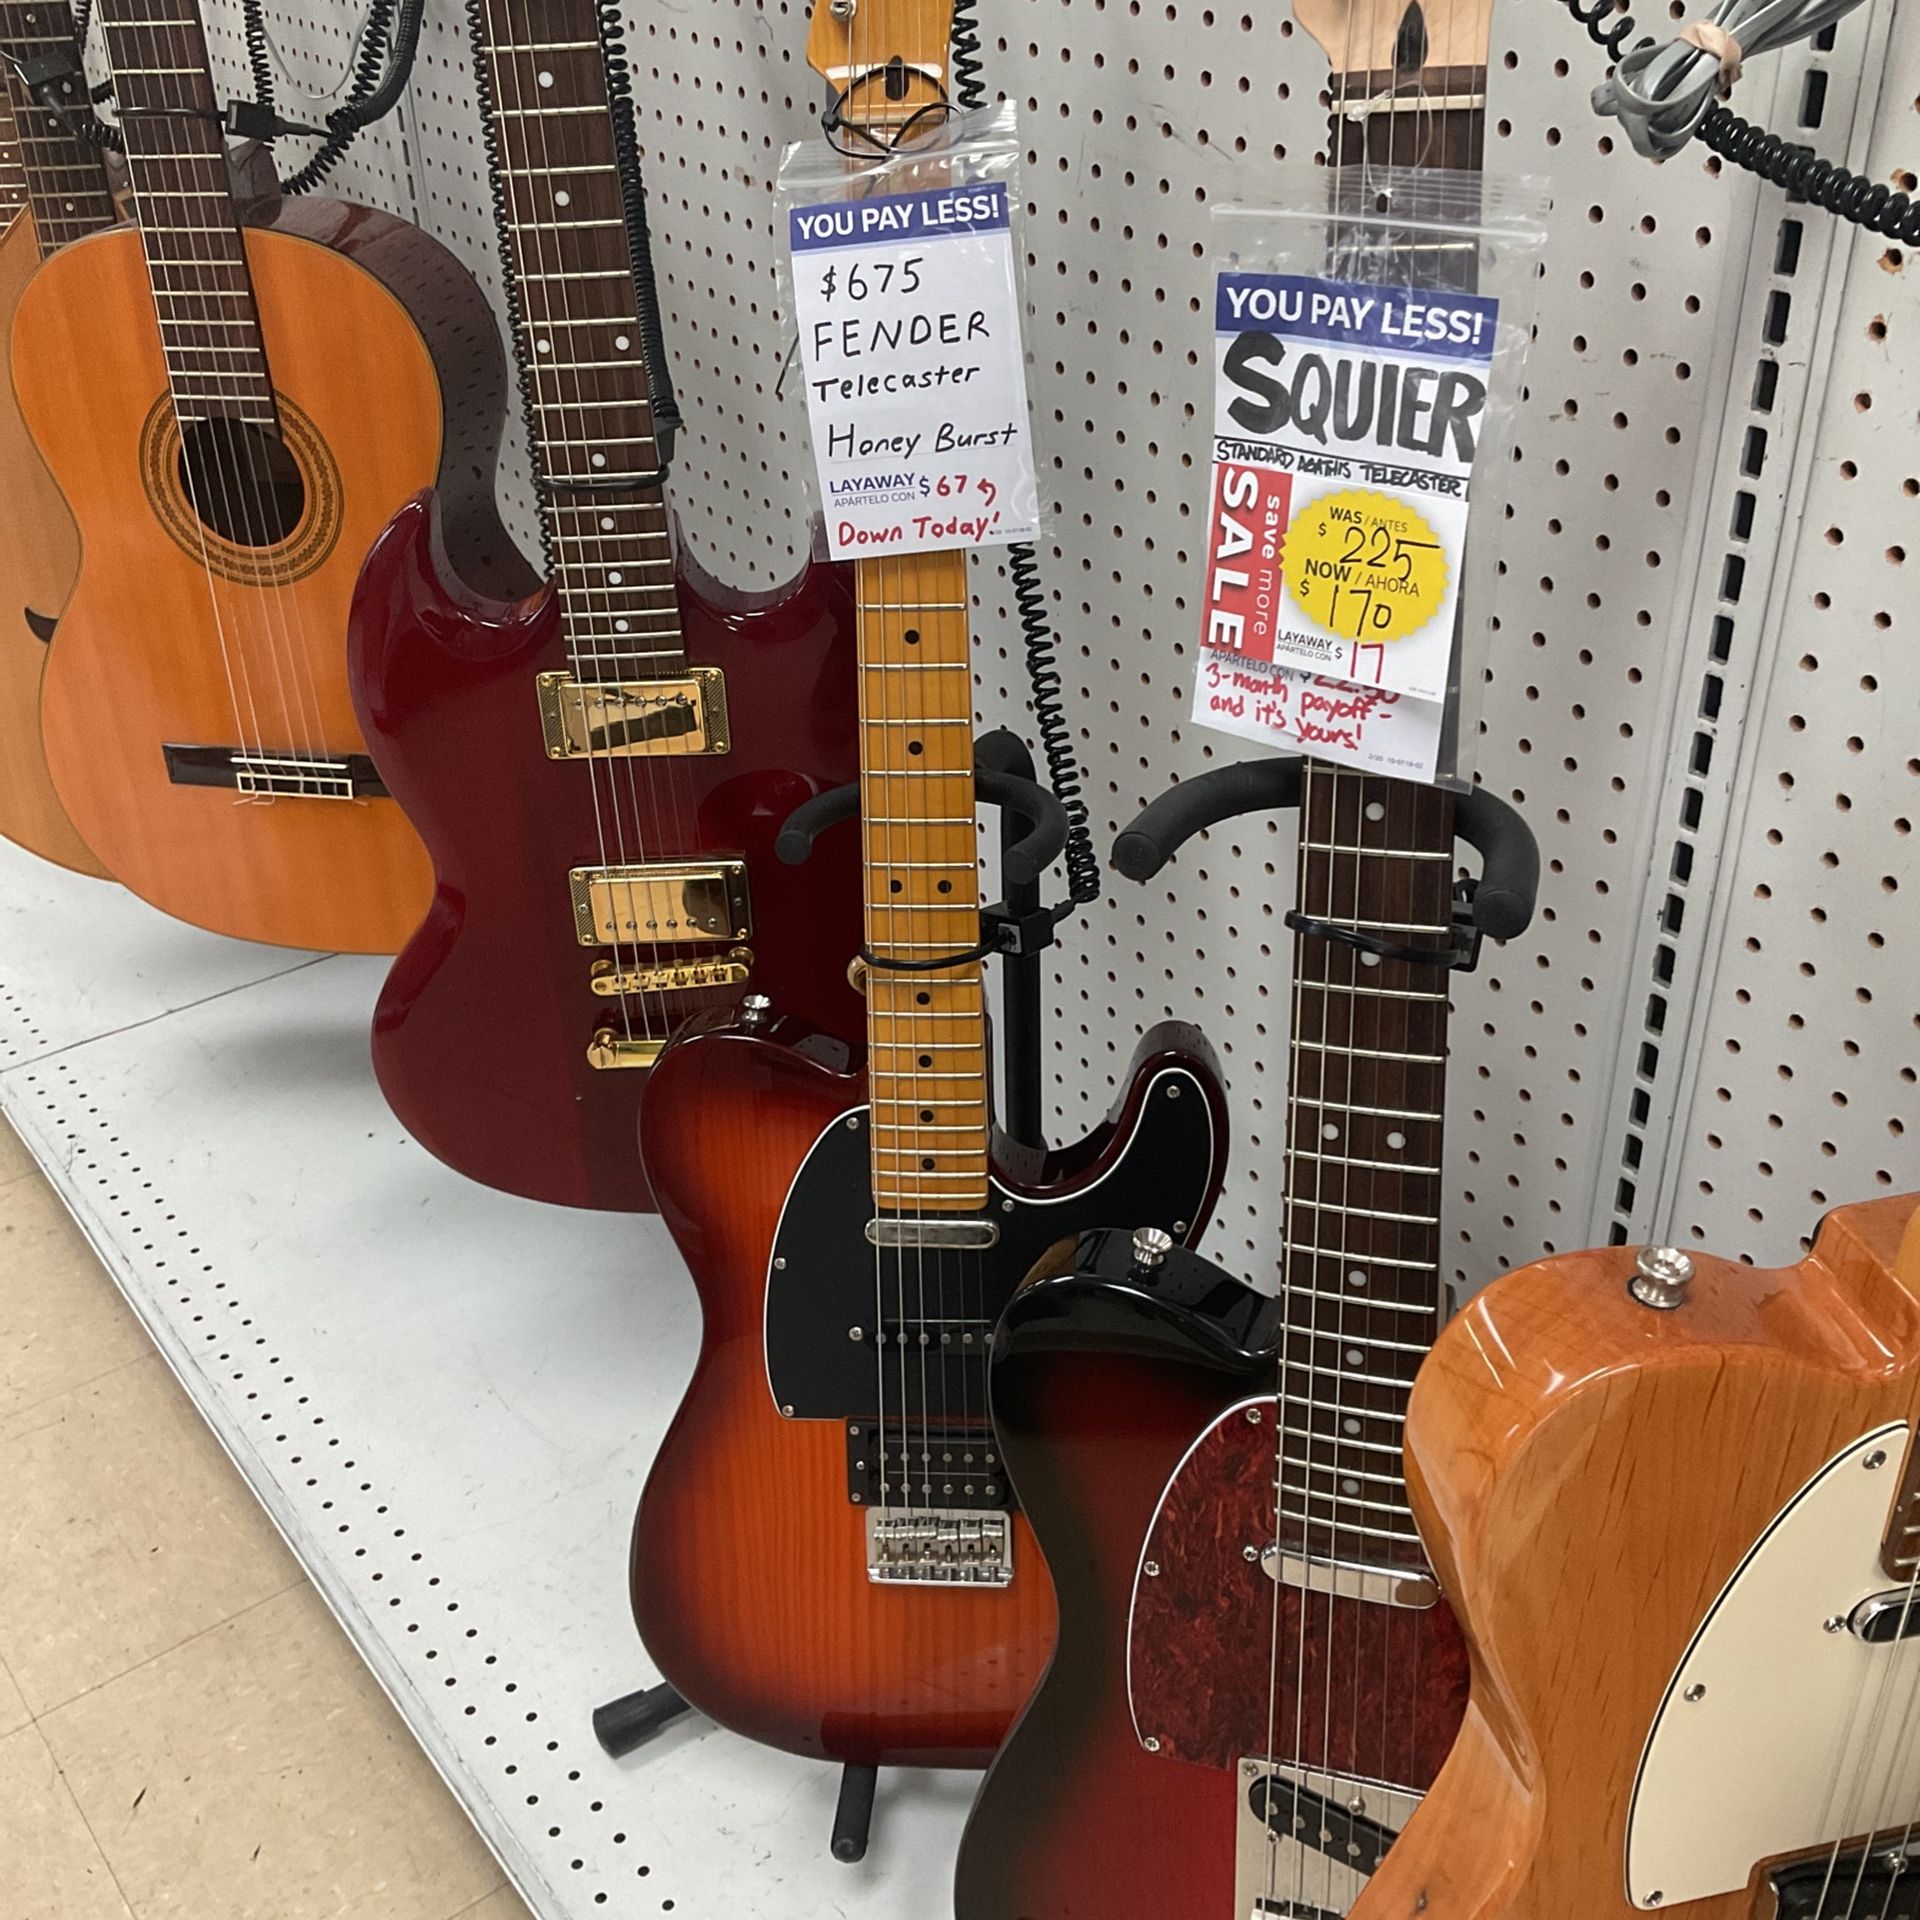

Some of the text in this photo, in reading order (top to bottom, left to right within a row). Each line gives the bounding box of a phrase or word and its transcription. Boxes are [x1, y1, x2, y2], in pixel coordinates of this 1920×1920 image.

[797, 193, 1000, 240] YOU PAY LESS!
[814, 310, 990, 362] FENDER
[1226, 287, 1484, 346] YOU PAY LESS!
[812, 365, 980, 402] Telecaster
[1222, 330, 1488, 463] SQUIER
[828, 421, 1018, 460] Honey Burst
[829, 473, 915, 494] LAYAWAY
[1216, 440, 1294, 468] STANDARD
[1359, 463, 1462, 498] TELECASTER
[891, 491, 915, 503] CON
[838, 511, 1000, 547] Down Today!
[1207, 466, 1259, 650] SALE
[1253, 494, 1281, 636] save more
[1305, 558, 1352, 582] NOW
[1278, 629, 1333, 650] LAYAWAY
[1210, 694, 1362, 750] and it's yours!
